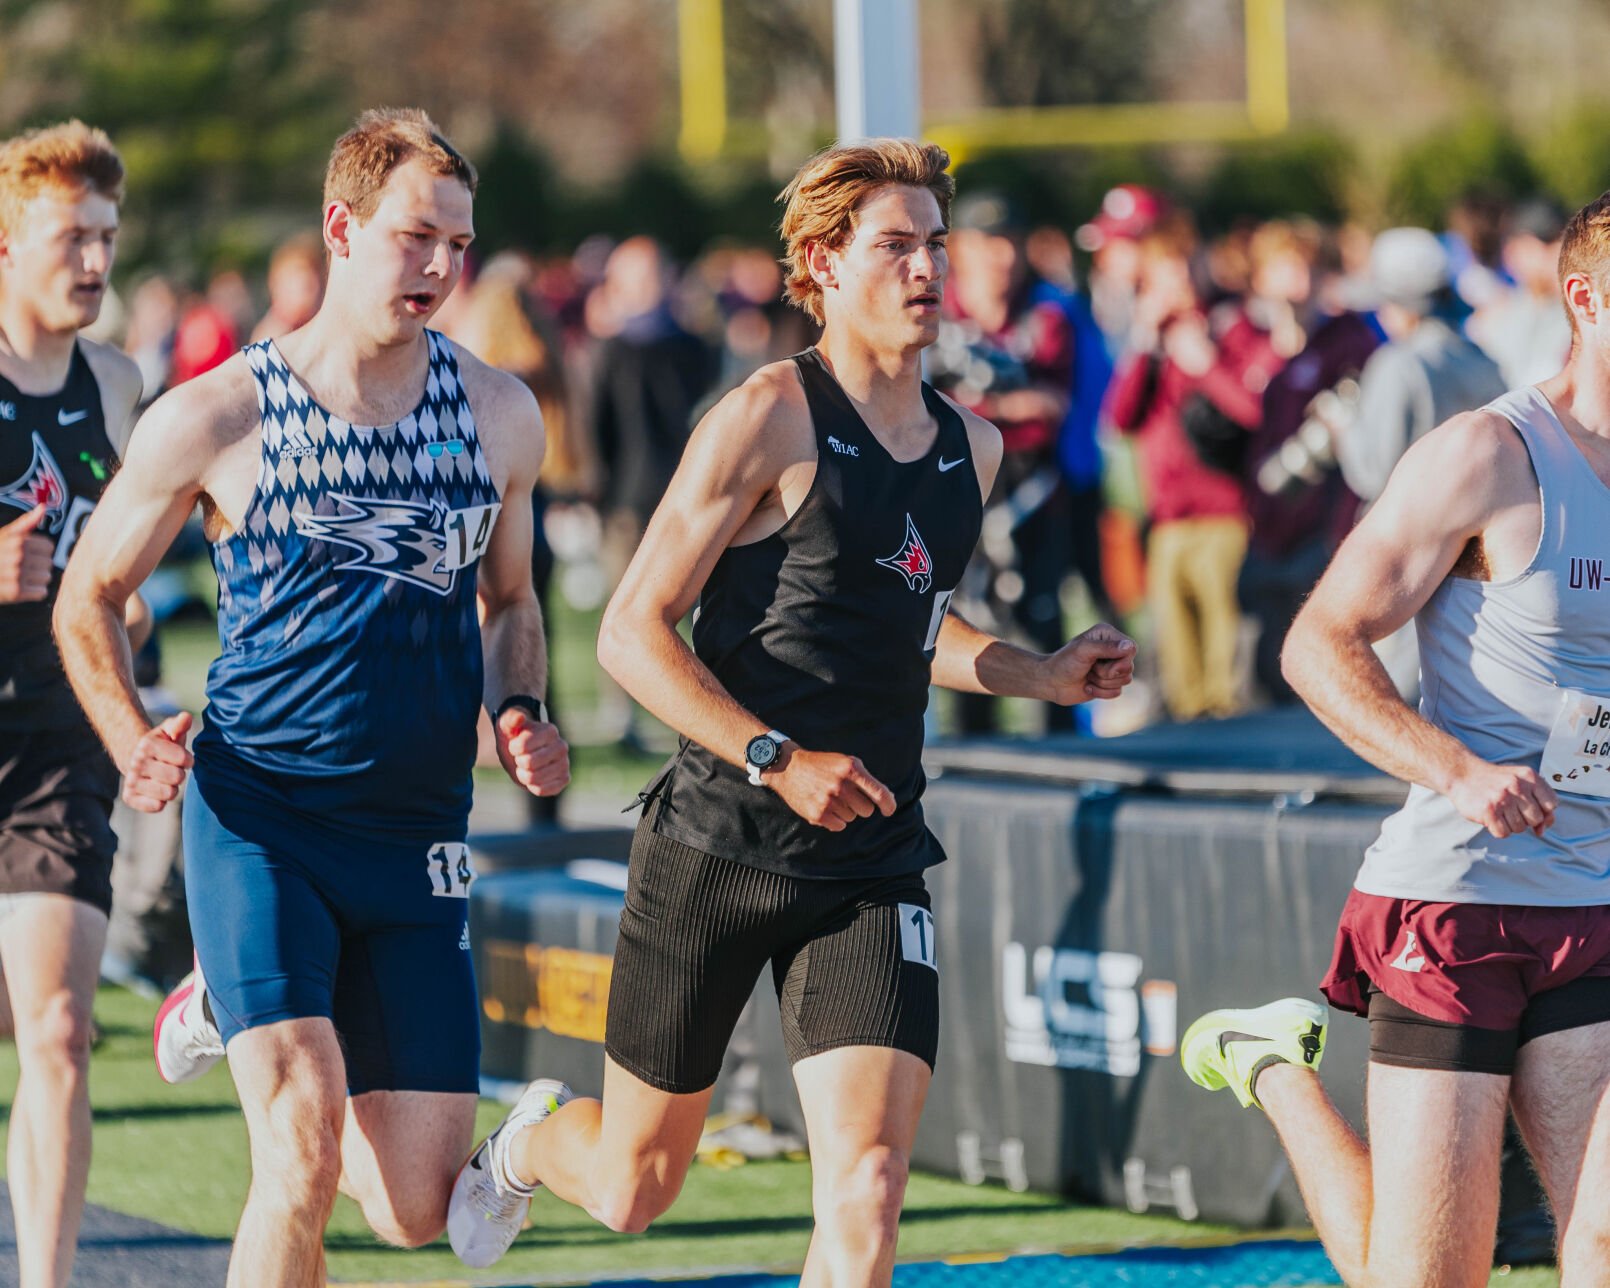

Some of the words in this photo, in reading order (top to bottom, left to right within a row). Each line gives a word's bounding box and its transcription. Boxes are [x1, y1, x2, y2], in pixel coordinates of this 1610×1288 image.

[279, 446, 319, 460] adidas
[448, 507, 492, 566] 14
[1569, 557, 1610, 591] UW-
[1588, 704, 1610, 729] Je
[1583, 739, 1598, 755] La
[431, 846, 471, 896] 14
